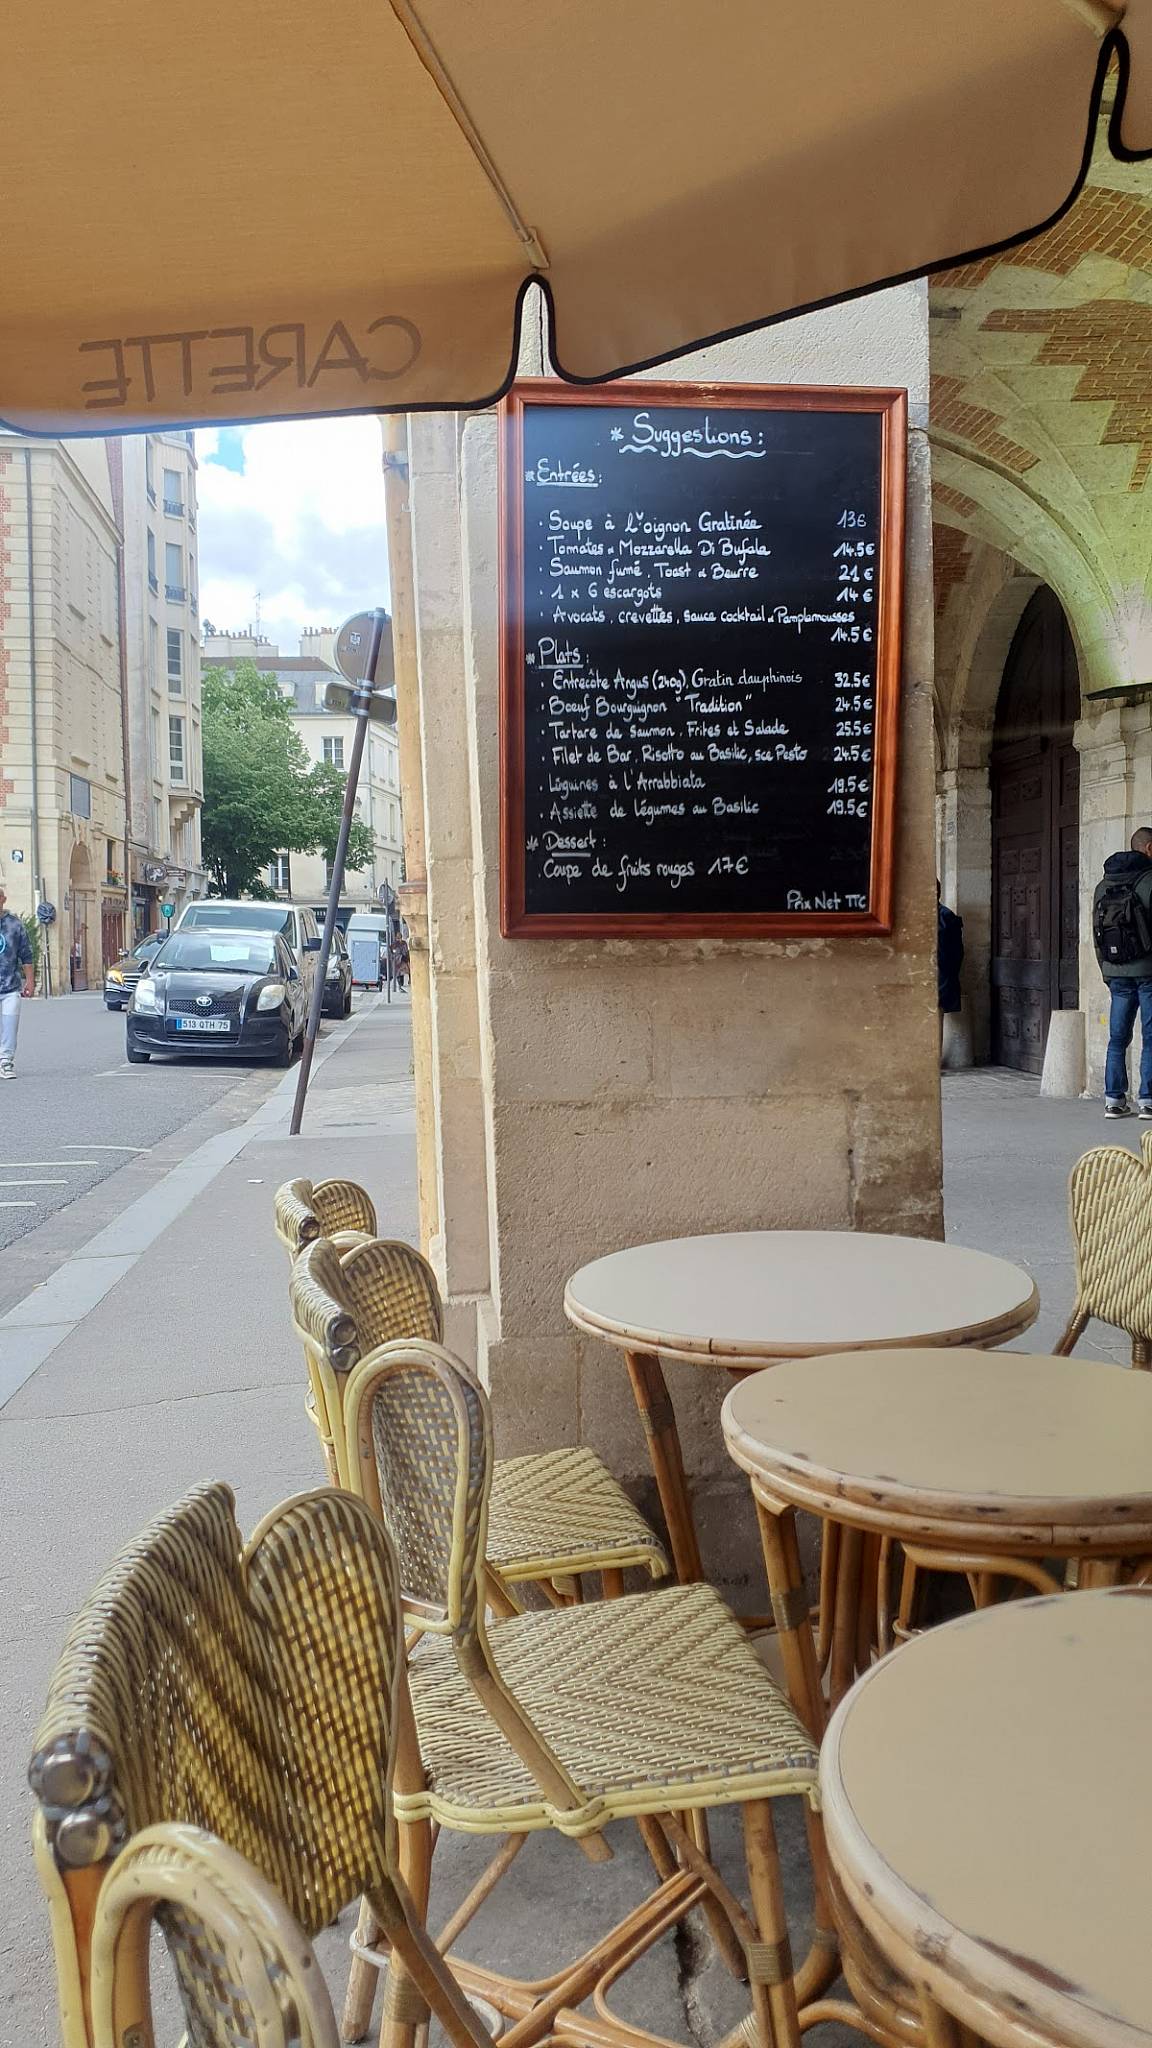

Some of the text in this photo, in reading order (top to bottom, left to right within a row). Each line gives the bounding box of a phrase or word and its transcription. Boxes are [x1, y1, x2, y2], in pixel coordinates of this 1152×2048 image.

[549, 510, 593, 541] Soupe
[604, 514, 615, 530] à
[699, 511, 763, 532] Gratinée
[547, 535, 603, 555] Tomates
[619, 538, 692, 556] Mozzarella
[698, 540, 715, 556] Di
[718, 538, 771, 565] Bufala
[550, 557, 602, 577] Saumon
[654, 562, 691, 578] Toast
[711, 563, 759, 580] Beurre
[551, 584, 563, 599] 1
[571, 588, 580, 599] x
[588, 583, 598, 598] 6
[603, 583, 662, 607] escargots
[721, 605, 765, 622] cocktail
[553, 669, 610, 690] Entrecôte
[614, 668, 649, 700] Angus
[692, 668, 734, 688] Gratin
[737, 667, 803, 692] dauphinois
[595, 696, 667, 722] Bourguignon
[549, 722, 598, 740] Tartare
[606, 722, 622, 739] de
[687, 721, 720, 738] Frites
[727, 721, 739, 736] et
[744, 719, 789, 736] Salade
[552, 747, 582, 765] Filet
[587, 746, 601, 760] de
[642, 743, 686, 762] Risotto
[690, 752, 704, 761] au
[776, 742, 808, 761] Pesto
[608, 774, 617, 790] à
[550, 801, 598, 824] Assiette
[610, 800, 626, 818] de
[693, 805, 707, 814] au
[712, 795, 760, 815] Basilic
[543, 858, 582, 885] Coupe
[592, 857, 613, 877] de
[616, 855, 651, 892] fruits
[656, 861, 695, 888] rouges
[787, 890, 866, 910] Prix Net TTC
[183, 1020, 229, 1029] 513 QTH 75
